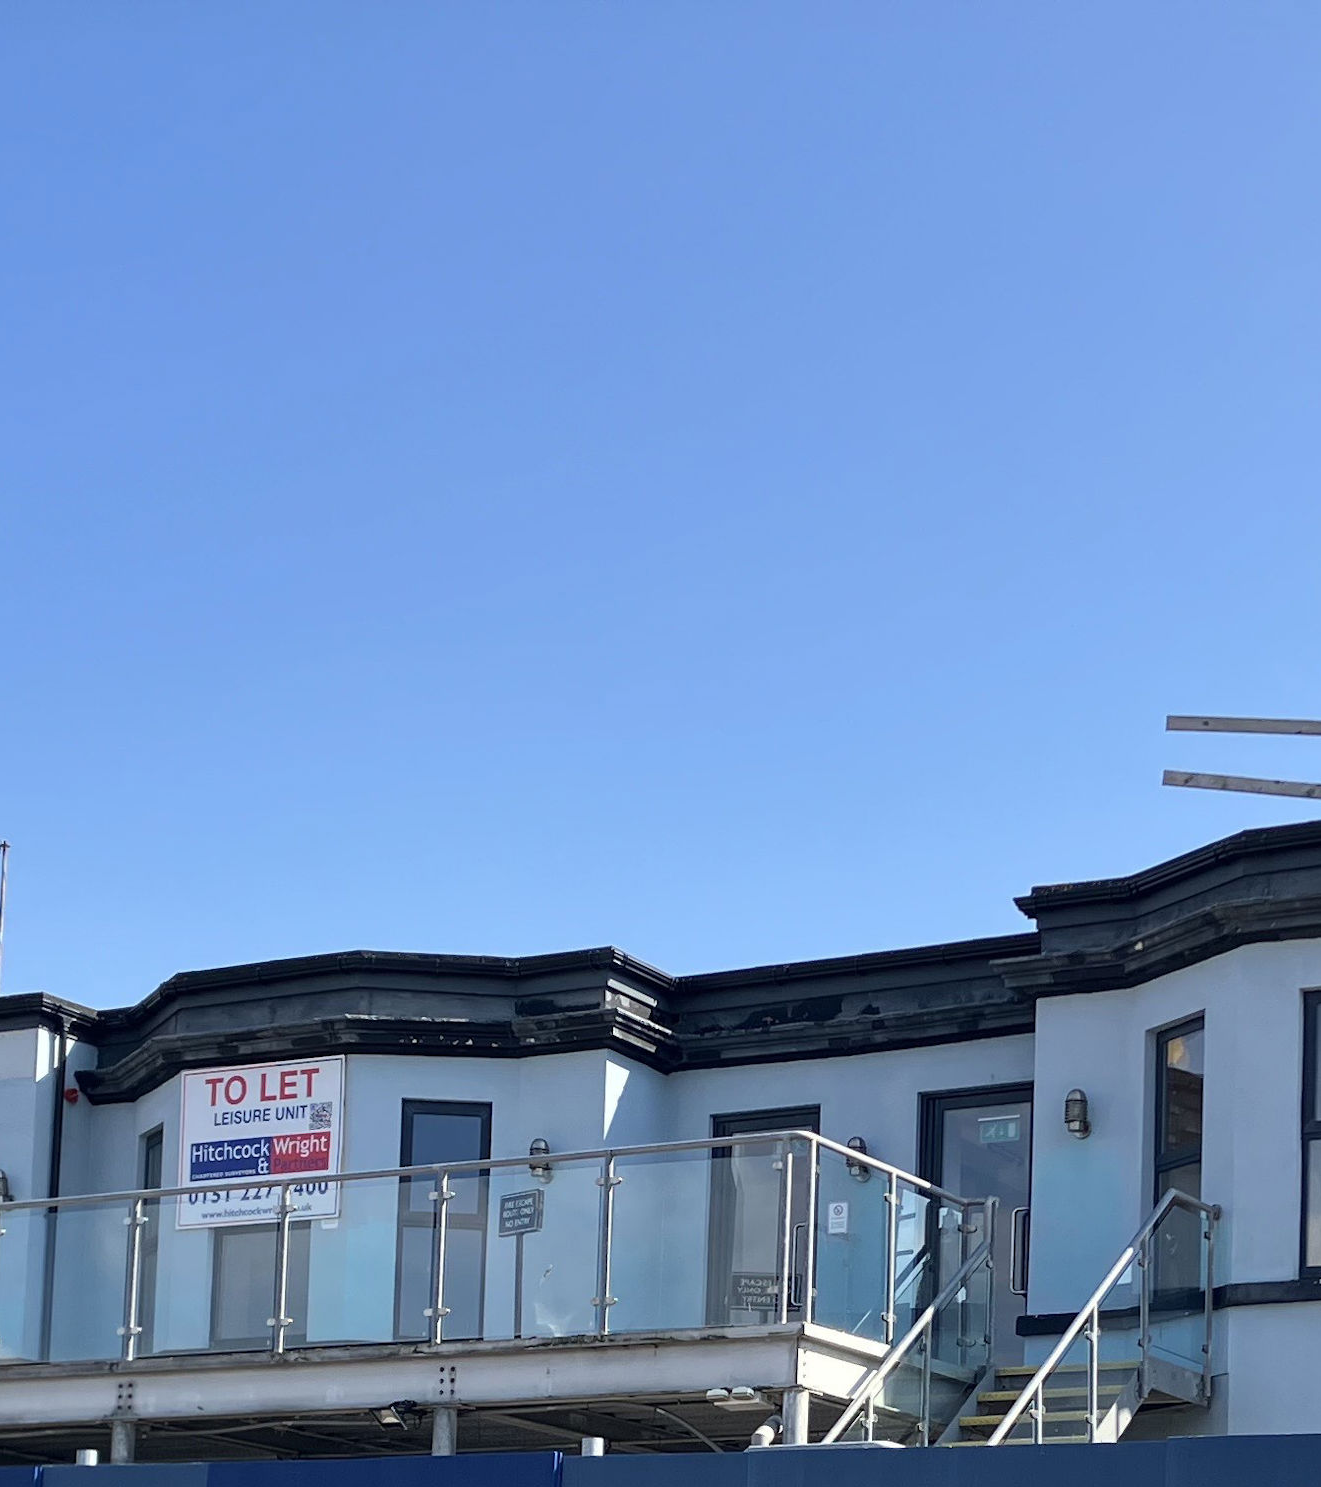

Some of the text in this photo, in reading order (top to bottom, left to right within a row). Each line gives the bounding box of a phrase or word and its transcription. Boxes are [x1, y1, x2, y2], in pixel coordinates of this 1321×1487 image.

[205, 1068, 319, 1107] TO LET
[214, 1105, 308, 1127] LEISURE UNIT
[191, 1134, 328, 1164] Hitchcock Wright
[257, 1157, 270, 1175] &
